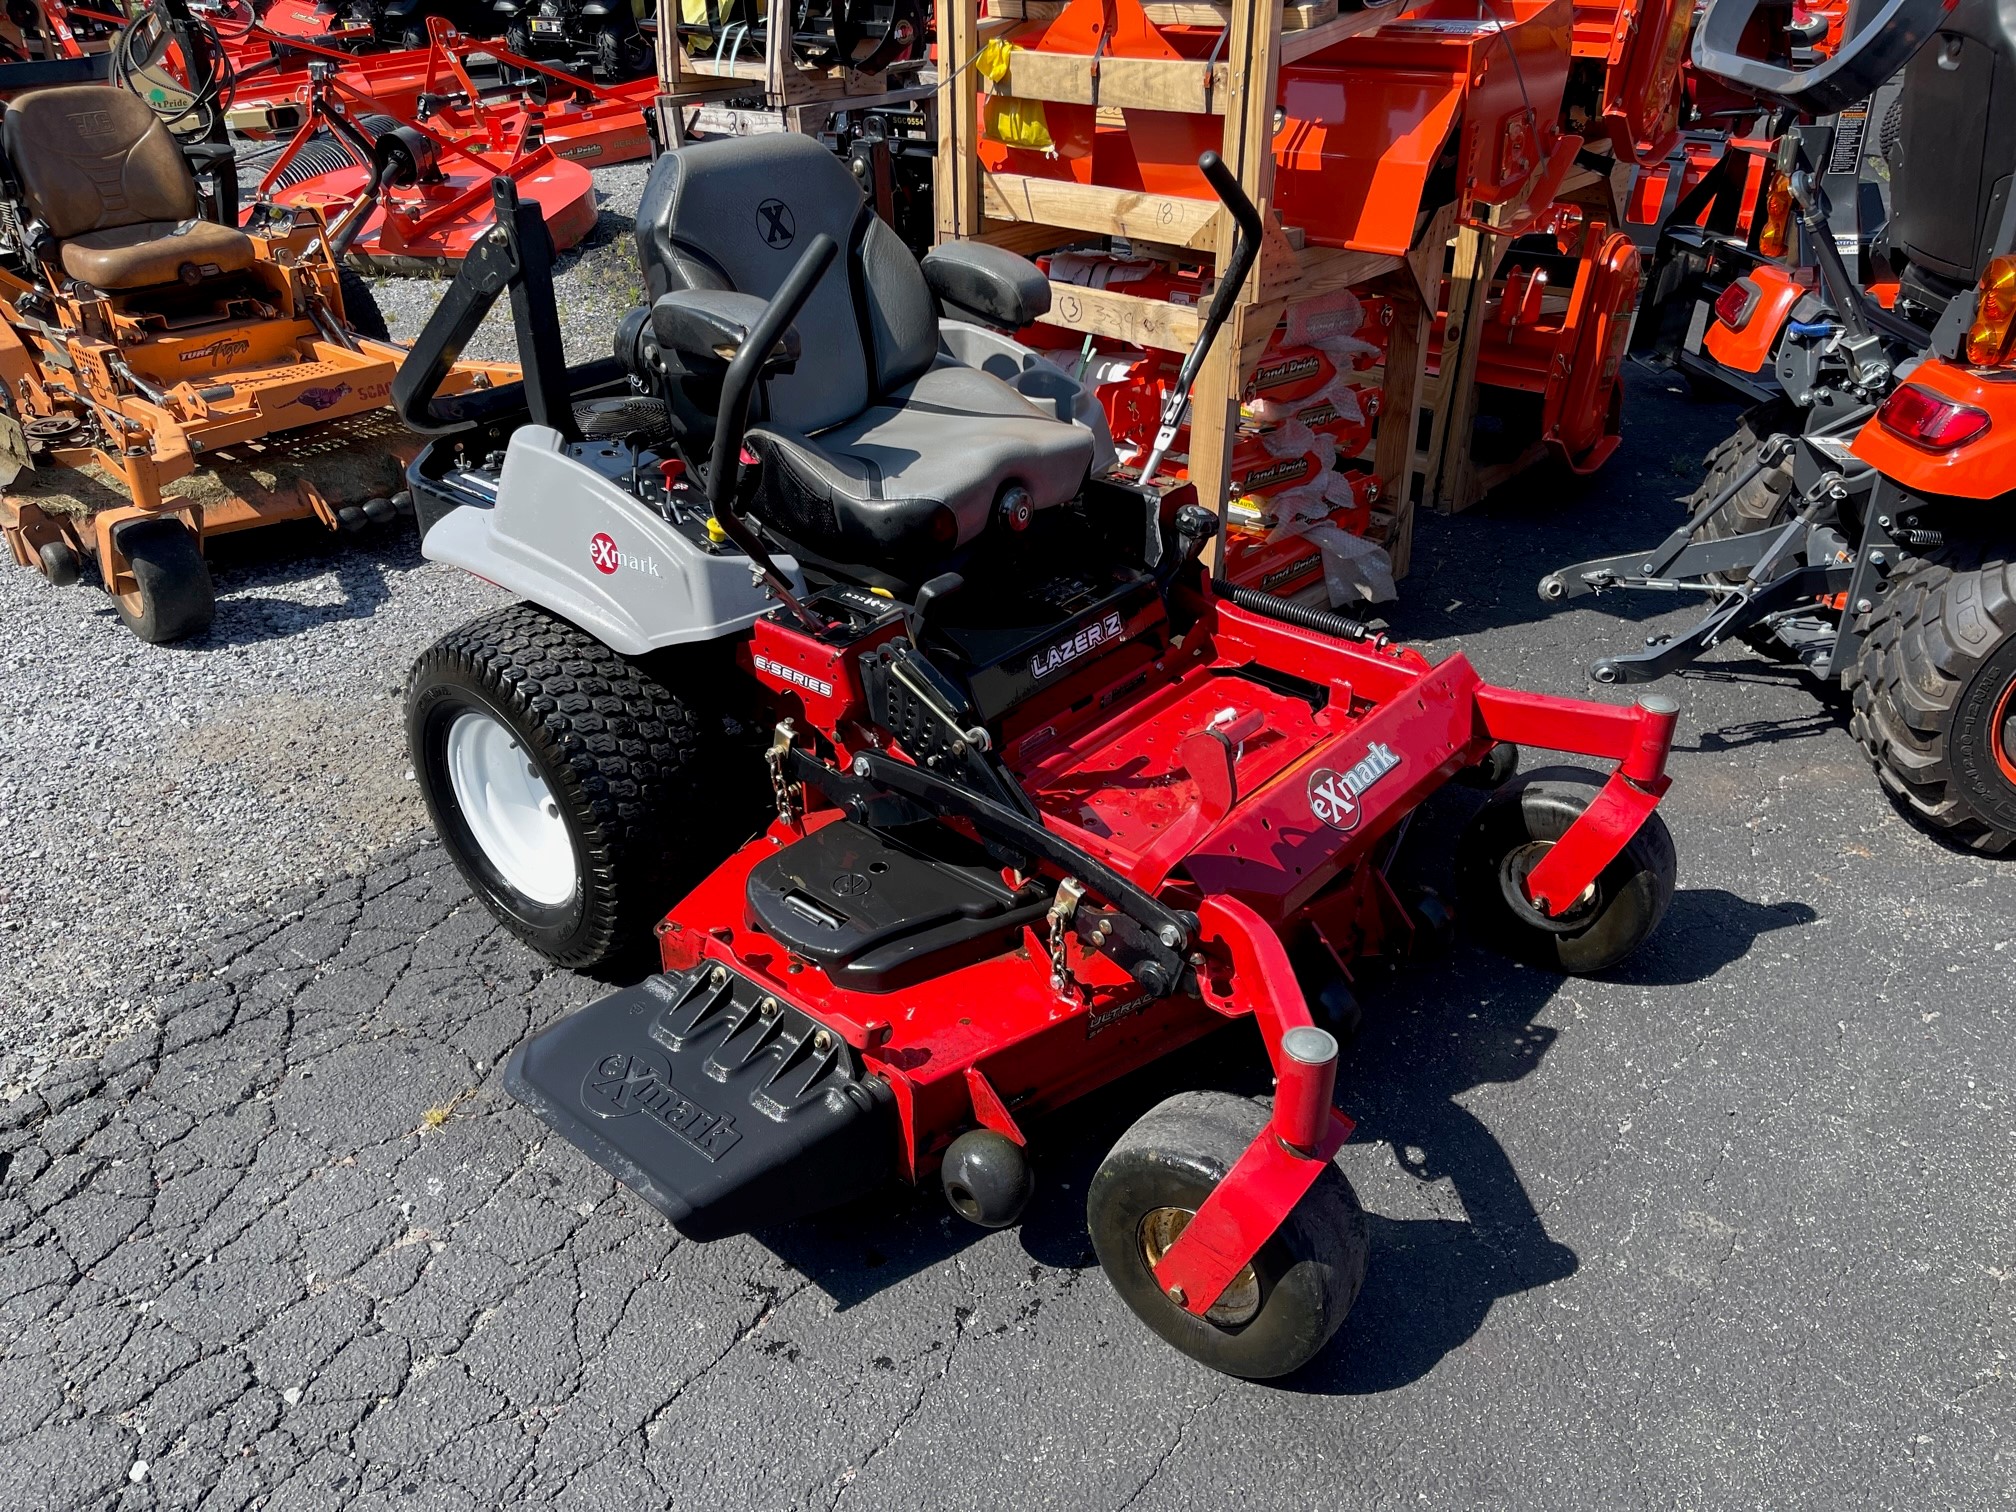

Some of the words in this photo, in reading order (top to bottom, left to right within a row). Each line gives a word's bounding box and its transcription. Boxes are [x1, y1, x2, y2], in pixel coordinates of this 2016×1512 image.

[163, 100, 188, 108] Pride
[180, 346, 212, 361] TURF
[1256, 364, 1286, 380] Land
[1289, 356, 1319, 372] Pride
[1247, 467, 1276, 482] Land
[1279, 459, 1308, 474] Pride
[589, 538, 661, 577] eXmark
[1263, 569, 1290, 585] Land
[1293, 554, 1321, 572] Pride
[1031, 623, 1103, 677] LAZER
[1104, 613, 1121, 639] Z
[755, 655, 832, 697] E-SERIES
[1312, 741, 1401, 824] eXmark
[1089, 993, 1153, 1028] ULTRAC
[592, 1053, 736, 1154] eXmark
